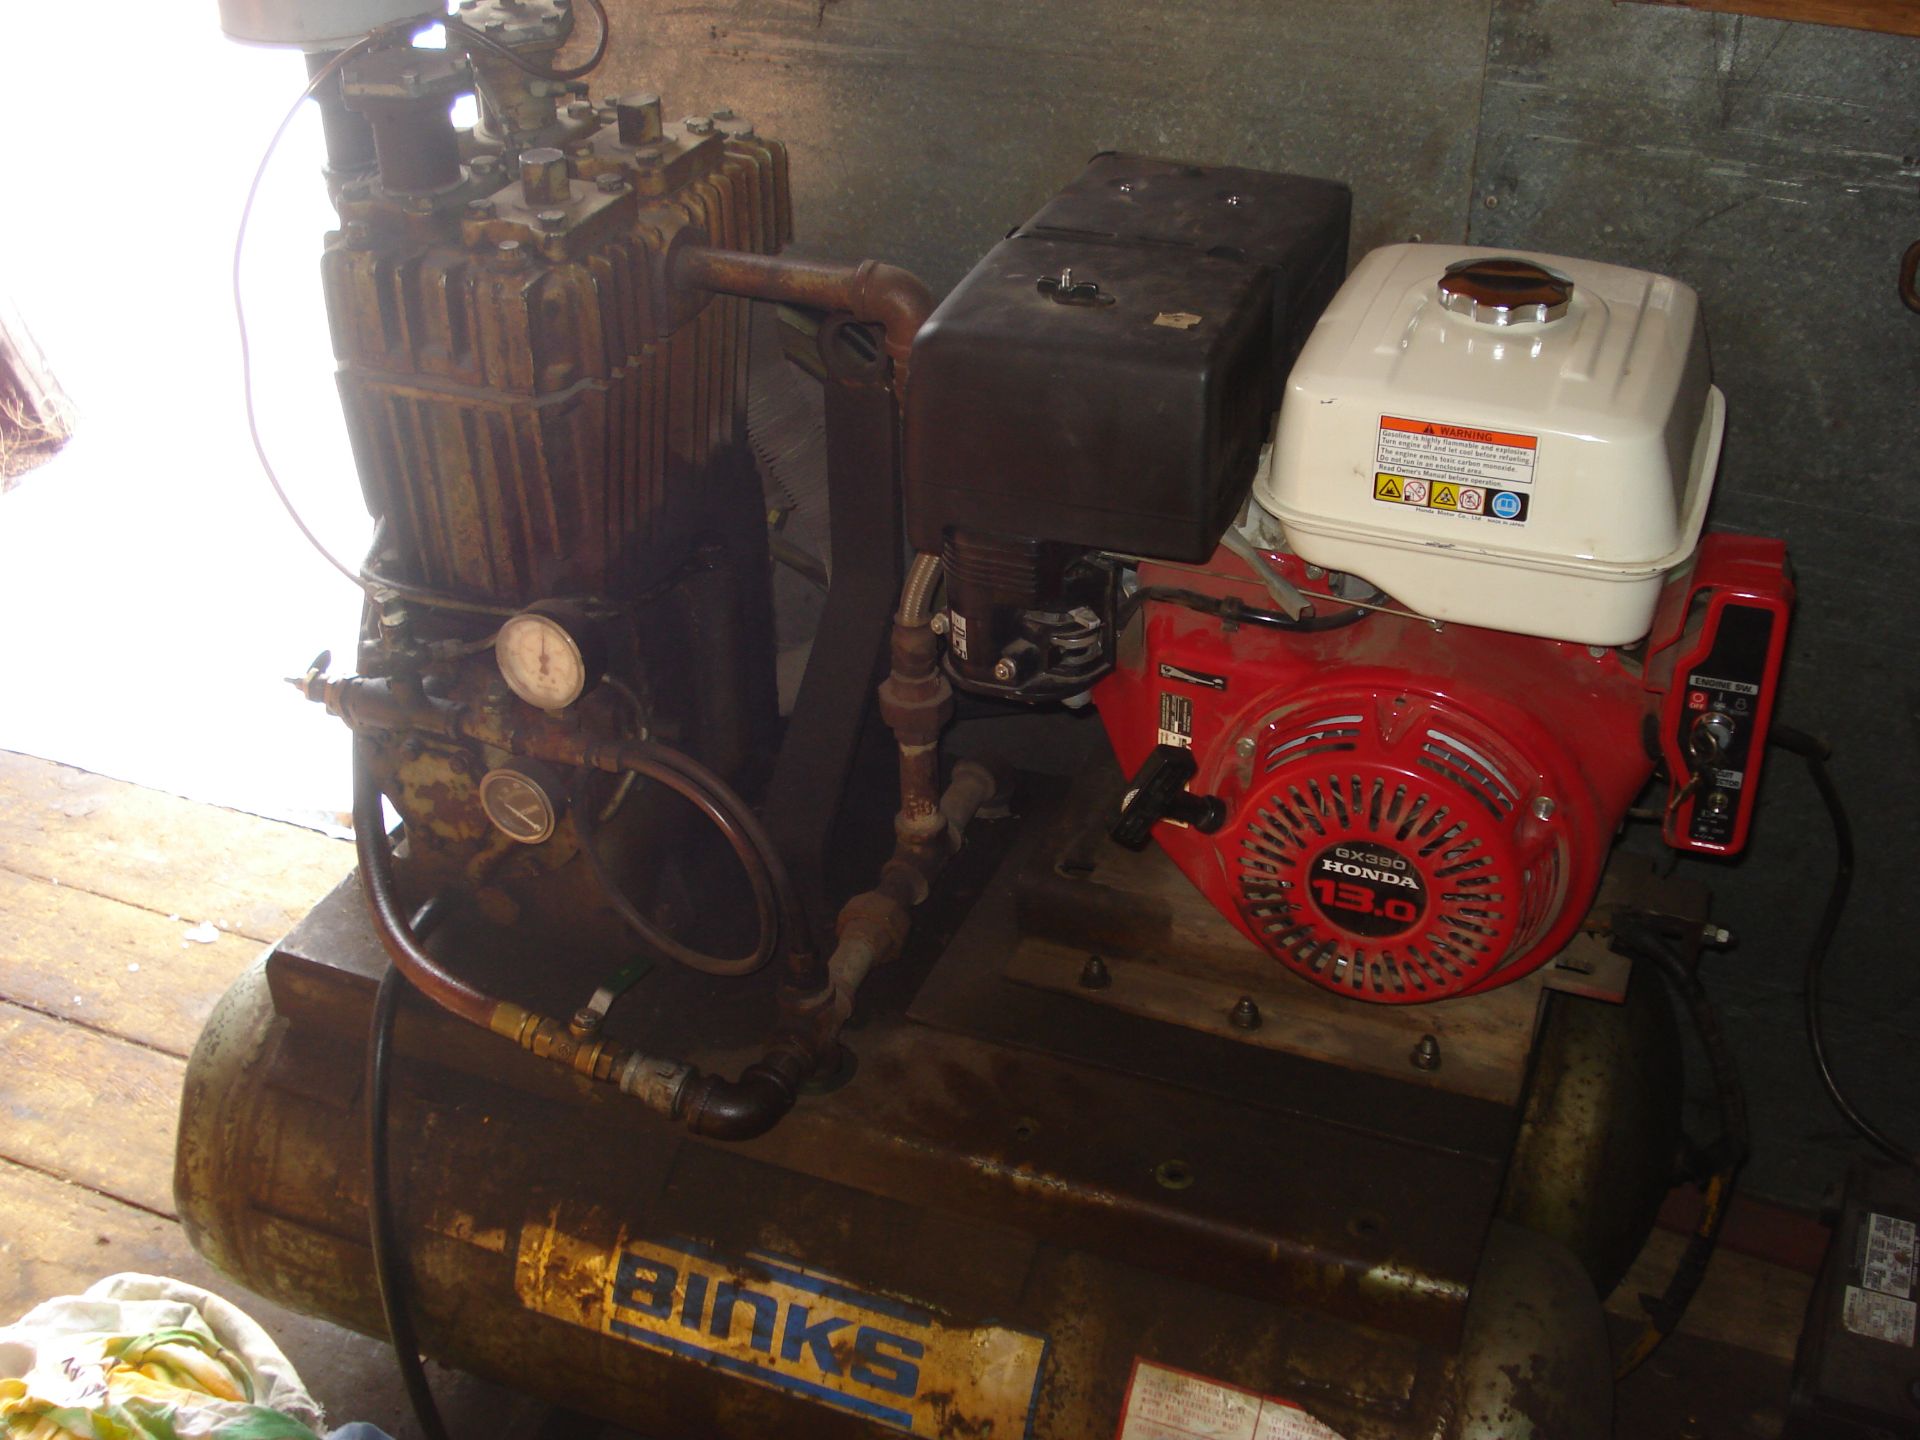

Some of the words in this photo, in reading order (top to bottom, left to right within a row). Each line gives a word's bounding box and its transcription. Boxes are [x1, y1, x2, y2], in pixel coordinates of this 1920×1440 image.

[1382, 430, 1411, 440] Gasoline
[1421, 436, 1440, 445] highly
[1443, 438, 1479, 450] flammable
[1481, 443, 1494, 451] and
[1440, 426, 1492, 442] WARNING
[1381, 447, 1393, 455] The
[1395, 451, 1417, 460] engine
[1419, 453, 1438, 461] emits
[1440, 455, 1455, 463] toxic
[1458, 458, 1481, 467] carbon
[1382, 437, 1397, 445] Turn
[1398, 440, 1420, 449] engine
[1459, 448, 1473, 456] cool
[1475, 450, 1496, 459] before
[1379, 464, 1394, 472] Read
[1396, 466, 1421, 476] Owner's
[1423, 470, 1446, 480] Manual
[1448, 473, 1469, 483] before
[1435, 463, 1465, 472] enclosed
[1695, 677, 1732, 689] ENGINE
[1735, 684, 1752, 693] SW.
[1335, 847, 1406, 870] GX390
[1322, 859, 1420, 890] HONDA
[1312, 880, 1416, 922] 13.0
